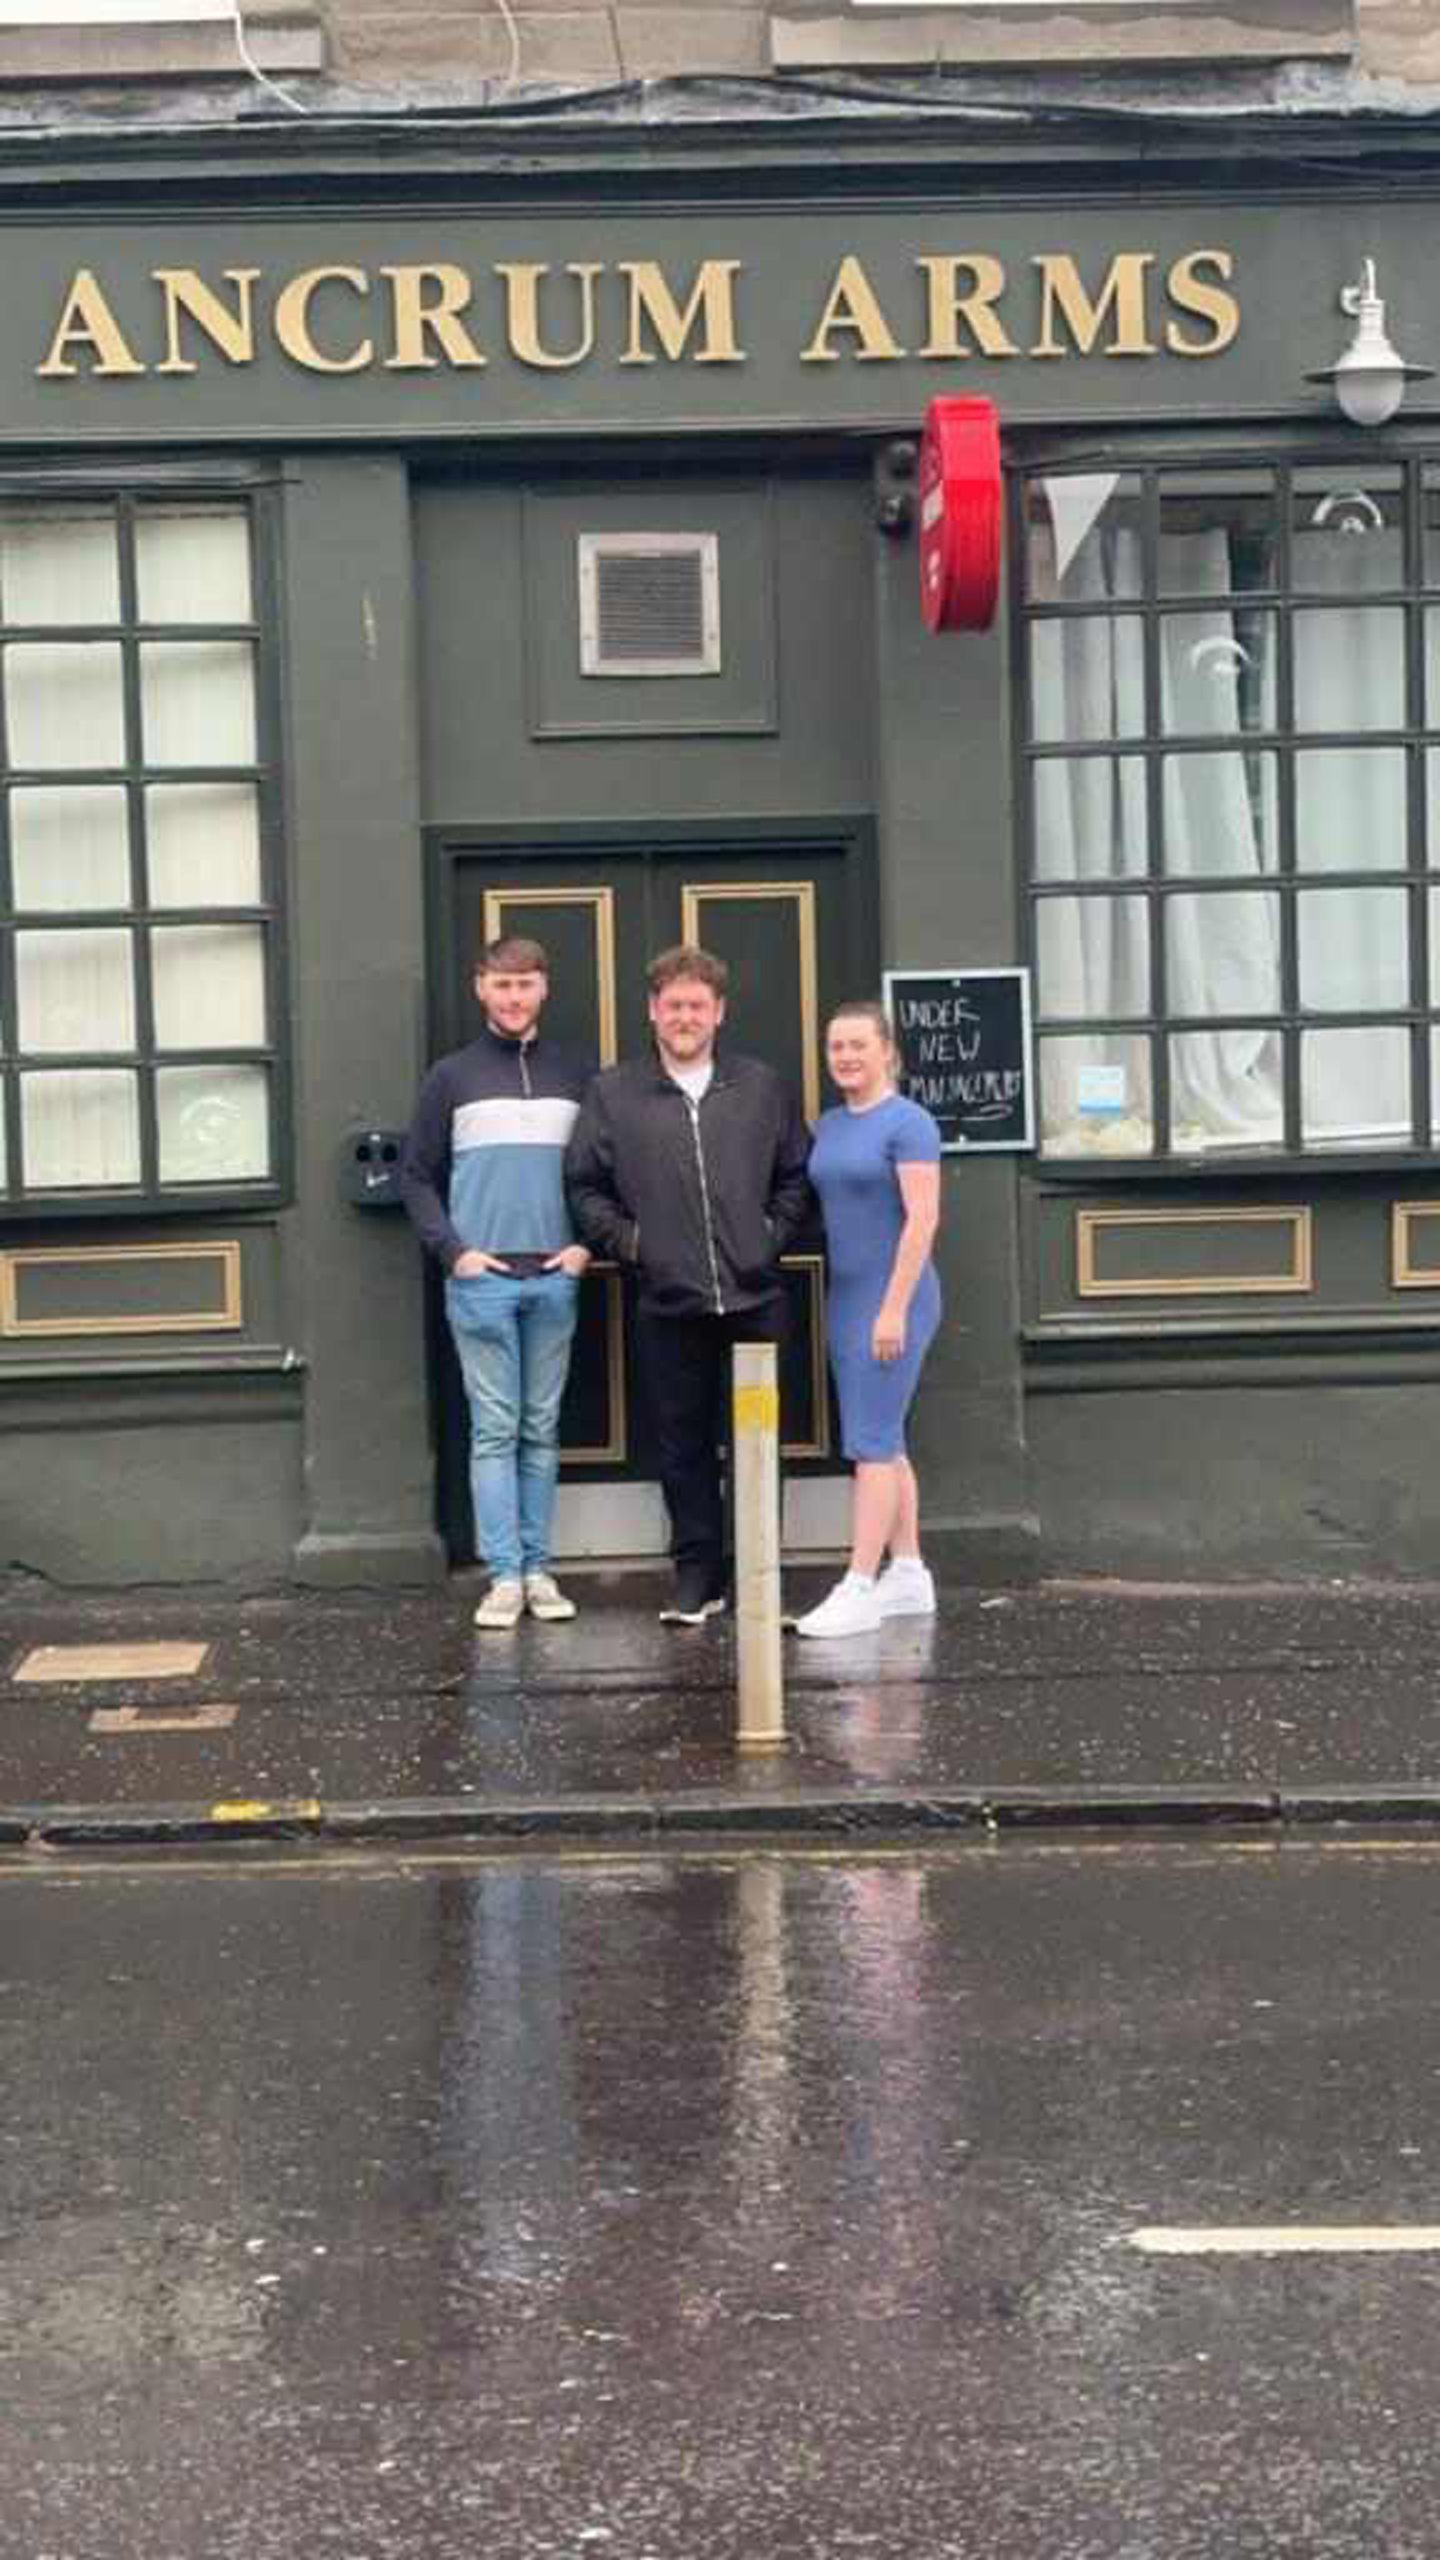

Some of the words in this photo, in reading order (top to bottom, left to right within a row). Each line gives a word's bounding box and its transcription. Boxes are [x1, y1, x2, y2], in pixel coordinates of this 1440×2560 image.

[36, 260, 747, 376] ANCRUM
[800, 250, 1241, 361] ARMS
[919, 1031, 980, 1062] NEW
